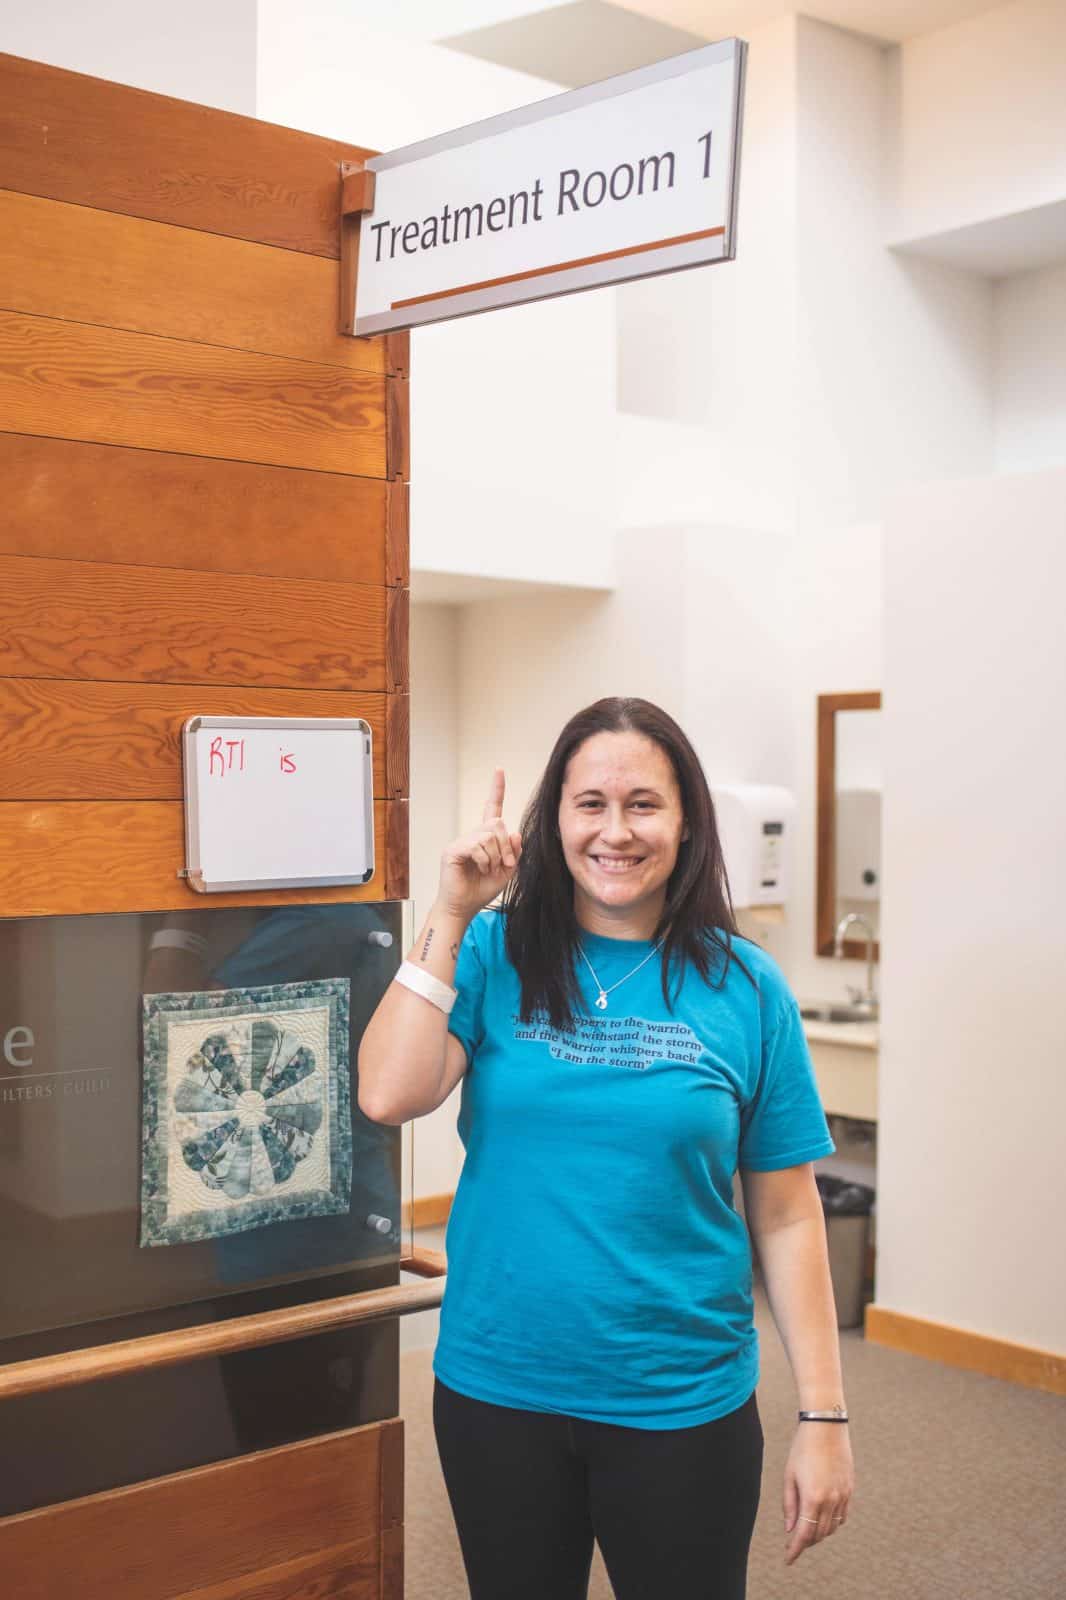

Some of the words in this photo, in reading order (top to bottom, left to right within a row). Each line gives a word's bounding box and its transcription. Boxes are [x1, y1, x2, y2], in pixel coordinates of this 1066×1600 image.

[370, 179, 544, 262] Treatment
[557, 150, 676, 216] Room
[697, 130, 713, 179] 1
[210, 736, 245, 776] RTI
[279, 748, 297, 773] is
[609, 1021, 622, 1029] to
[624, 1016, 644, 1028] the
[515, 1028, 537, 1040] and
[539, 1029, 559, 1042] the
[562, 1038, 606, 1053] warrior
[610, 1044, 664, 1059] whispers
[667, 1050, 697, 1065] back
[581, 1031, 639, 1042] withstand
[643, 1034, 662, 1046] the
[665, 1038, 702, 1052] storm
[564, 1052, 583, 1064] am
[586, 1054, 606, 1065] the
